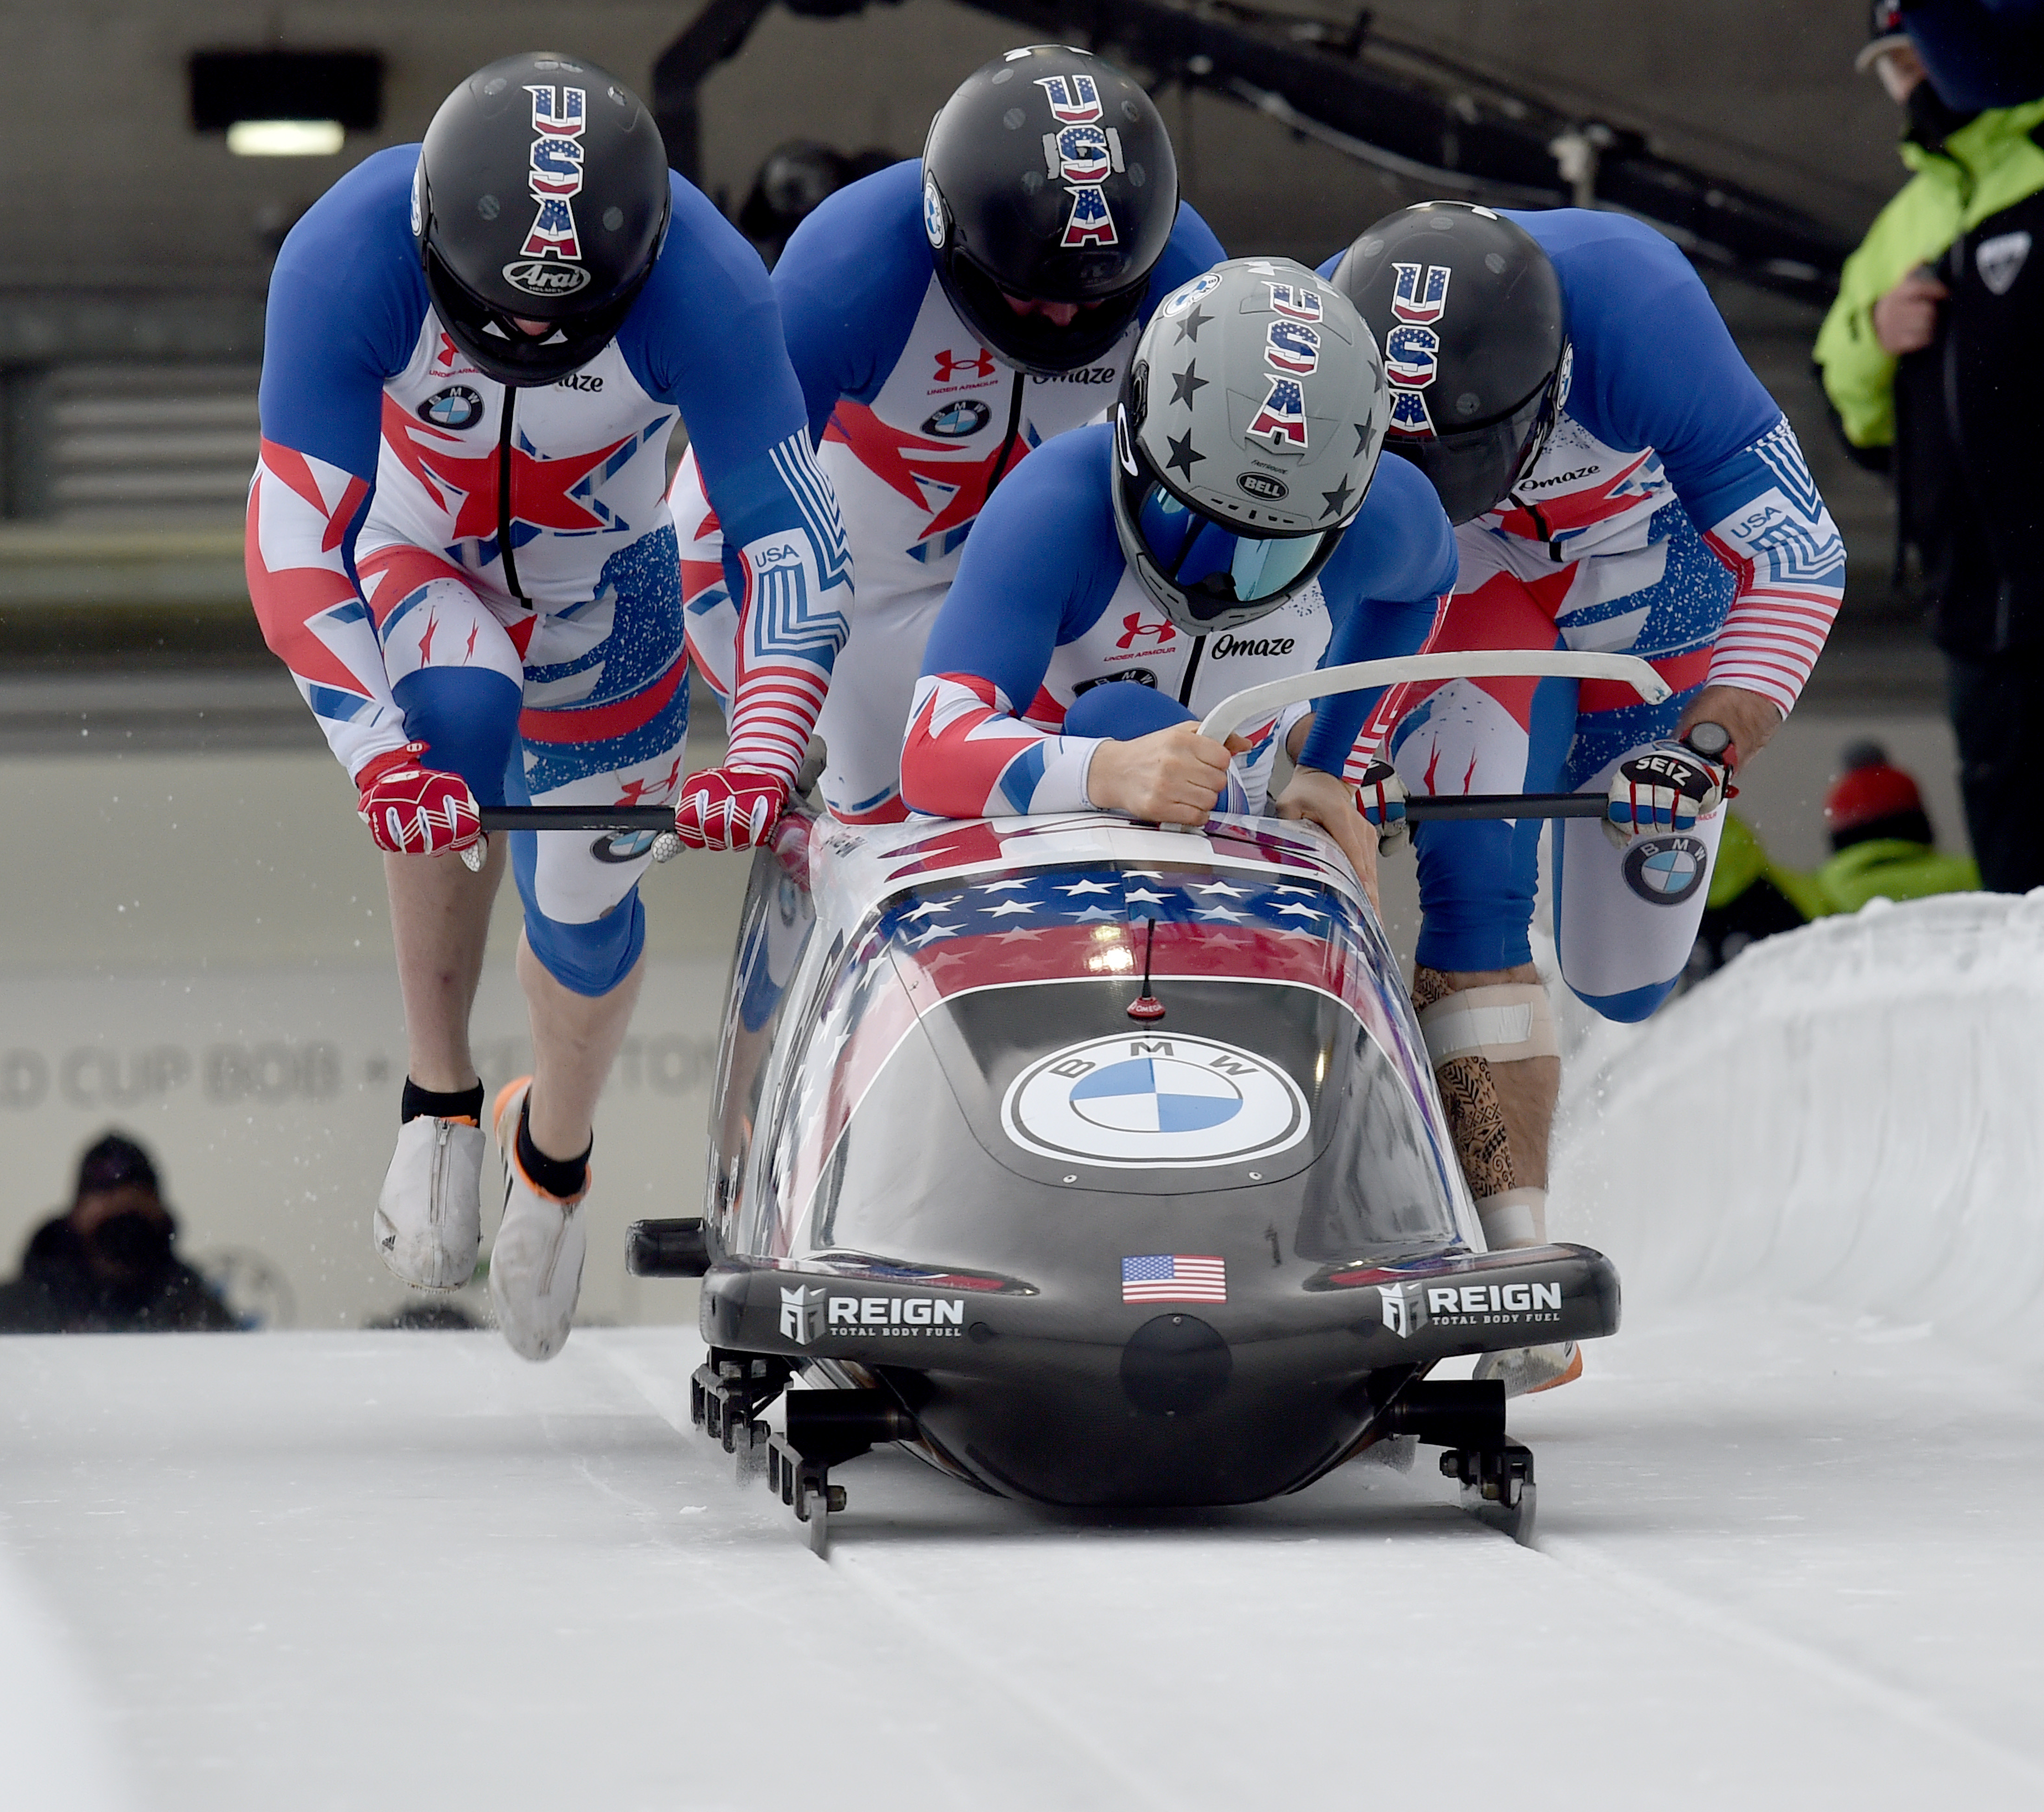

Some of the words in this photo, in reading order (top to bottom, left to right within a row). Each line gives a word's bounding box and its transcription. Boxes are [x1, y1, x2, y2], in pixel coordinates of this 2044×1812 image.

[520, 85, 586, 260] USA
[1033, 75, 1118, 247] USA
[509, 264, 581, 288] Arai
[1384, 262, 1451, 436] USA
[1246, 281, 1323, 448] USA
[429, 387, 481, 405] BMW
[927, 386, 957, 395] UNDER
[959, 380, 998, 390] ARMOUR
[932, 402, 986, 421] BMW
[1244, 476, 1280, 497] BELL
[1518, 465, 1601, 491] Omaze
[1730, 506, 1782, 538] USA
[755, 544, 799, 568] USA
[1103, 653, 1133, 662] UNDER
[1135, 647, 1176, 659] ARMOUR
[1212, 634, 1295, 660] Omaze
[1635, 757, 1692, 787] SEIZ
[1640, 838, 1707, 862] BMW
[1135, 1004, 1162, 1013] OMEGA
[1048, 1041, 1260, 1079] BMW
[1428, 1282, 1562, 1314] REIGN
[828, 1297, 964, 1325] REIGN
[1432, 1316, 1477, 1326] TOTAL
[1483, 1314, 1520, 1323] BODY
[1525, 1313, 1561, 1322] FUEL
[830, 1327, 876, 1336] TOTAL
[882, 1327, 920, 1337] BODY
[926, 1328, 962, 1337] FUEL
